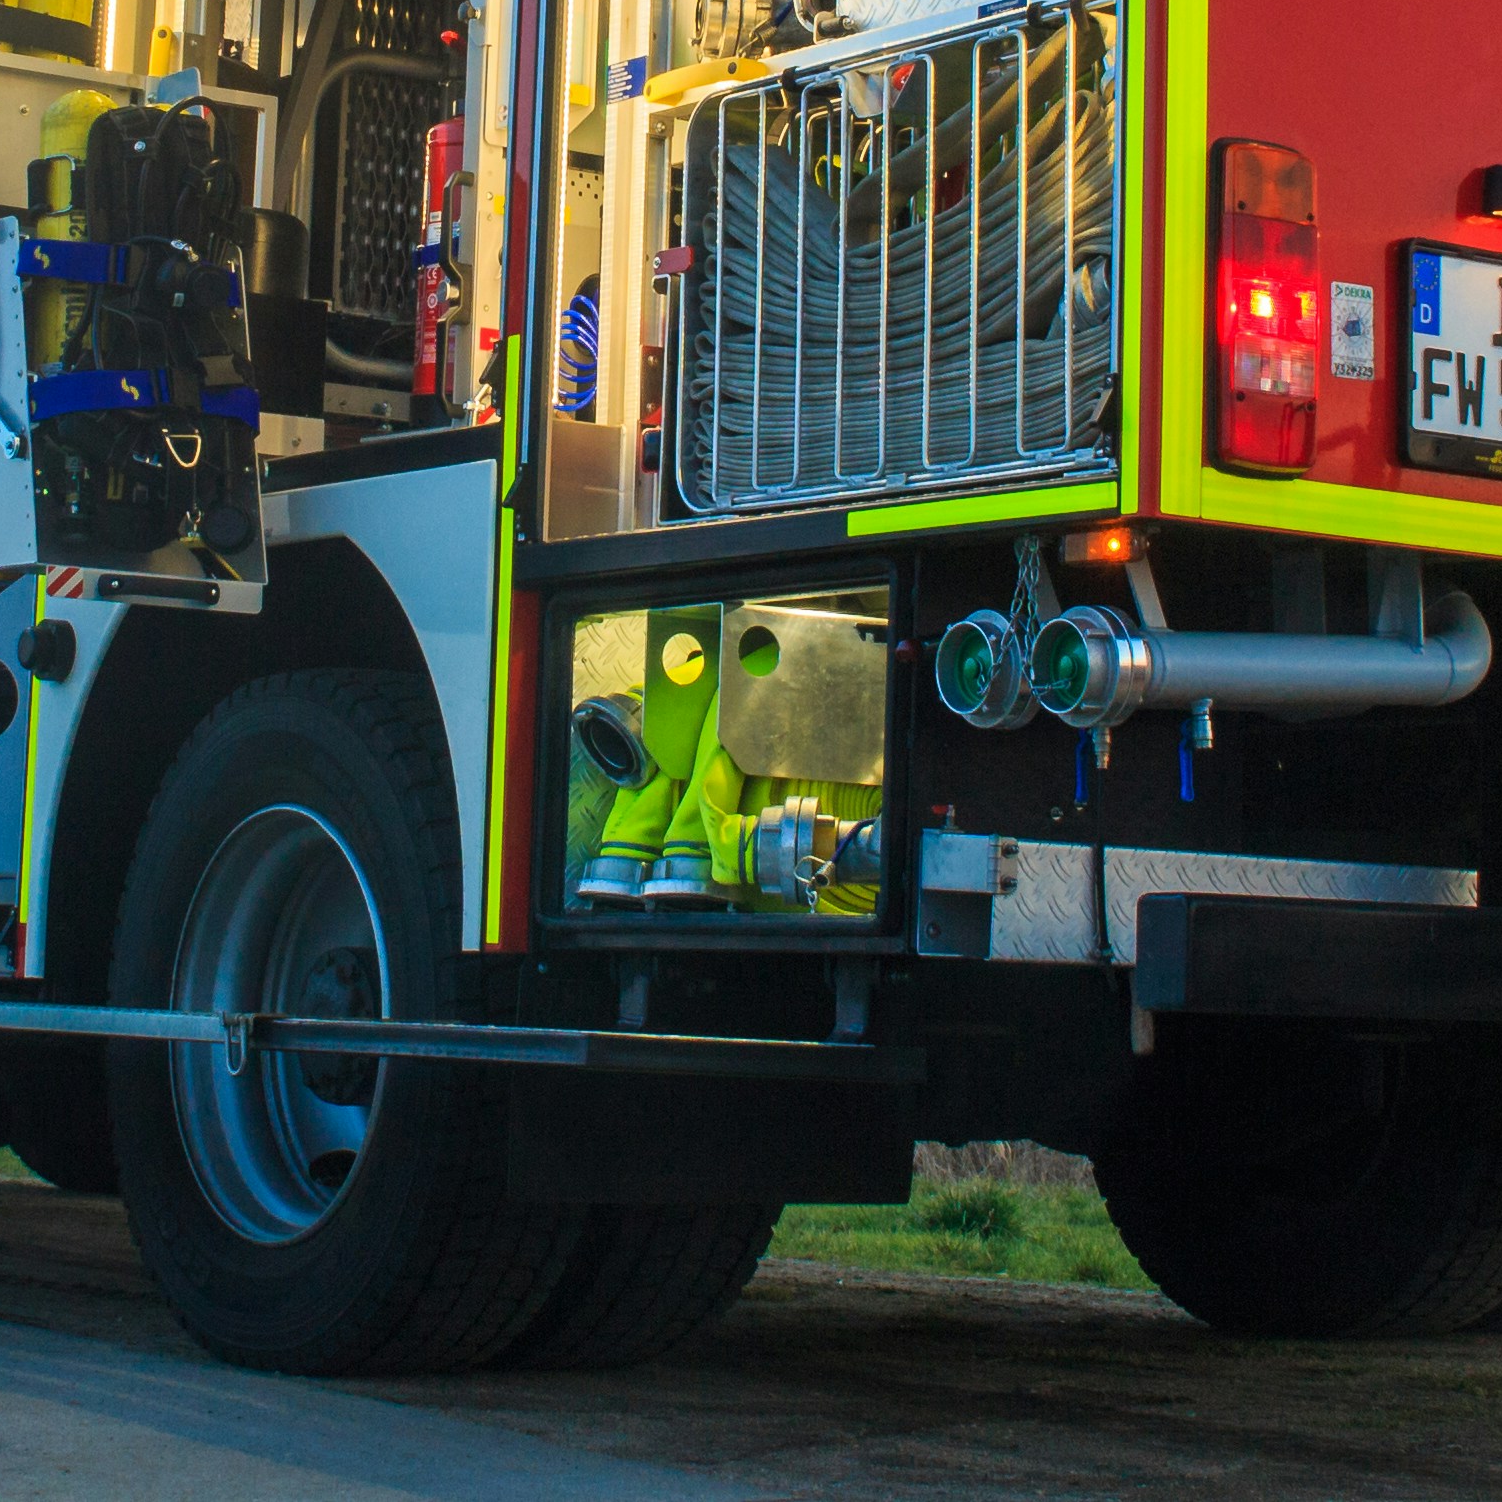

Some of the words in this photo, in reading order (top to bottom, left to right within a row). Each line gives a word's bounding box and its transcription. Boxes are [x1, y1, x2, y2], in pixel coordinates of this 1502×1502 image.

[1344, 286, 1372, 299] DEKRA
[1420, 304, 1432, 324] D
[1421, 348, 1486, 427] FW
